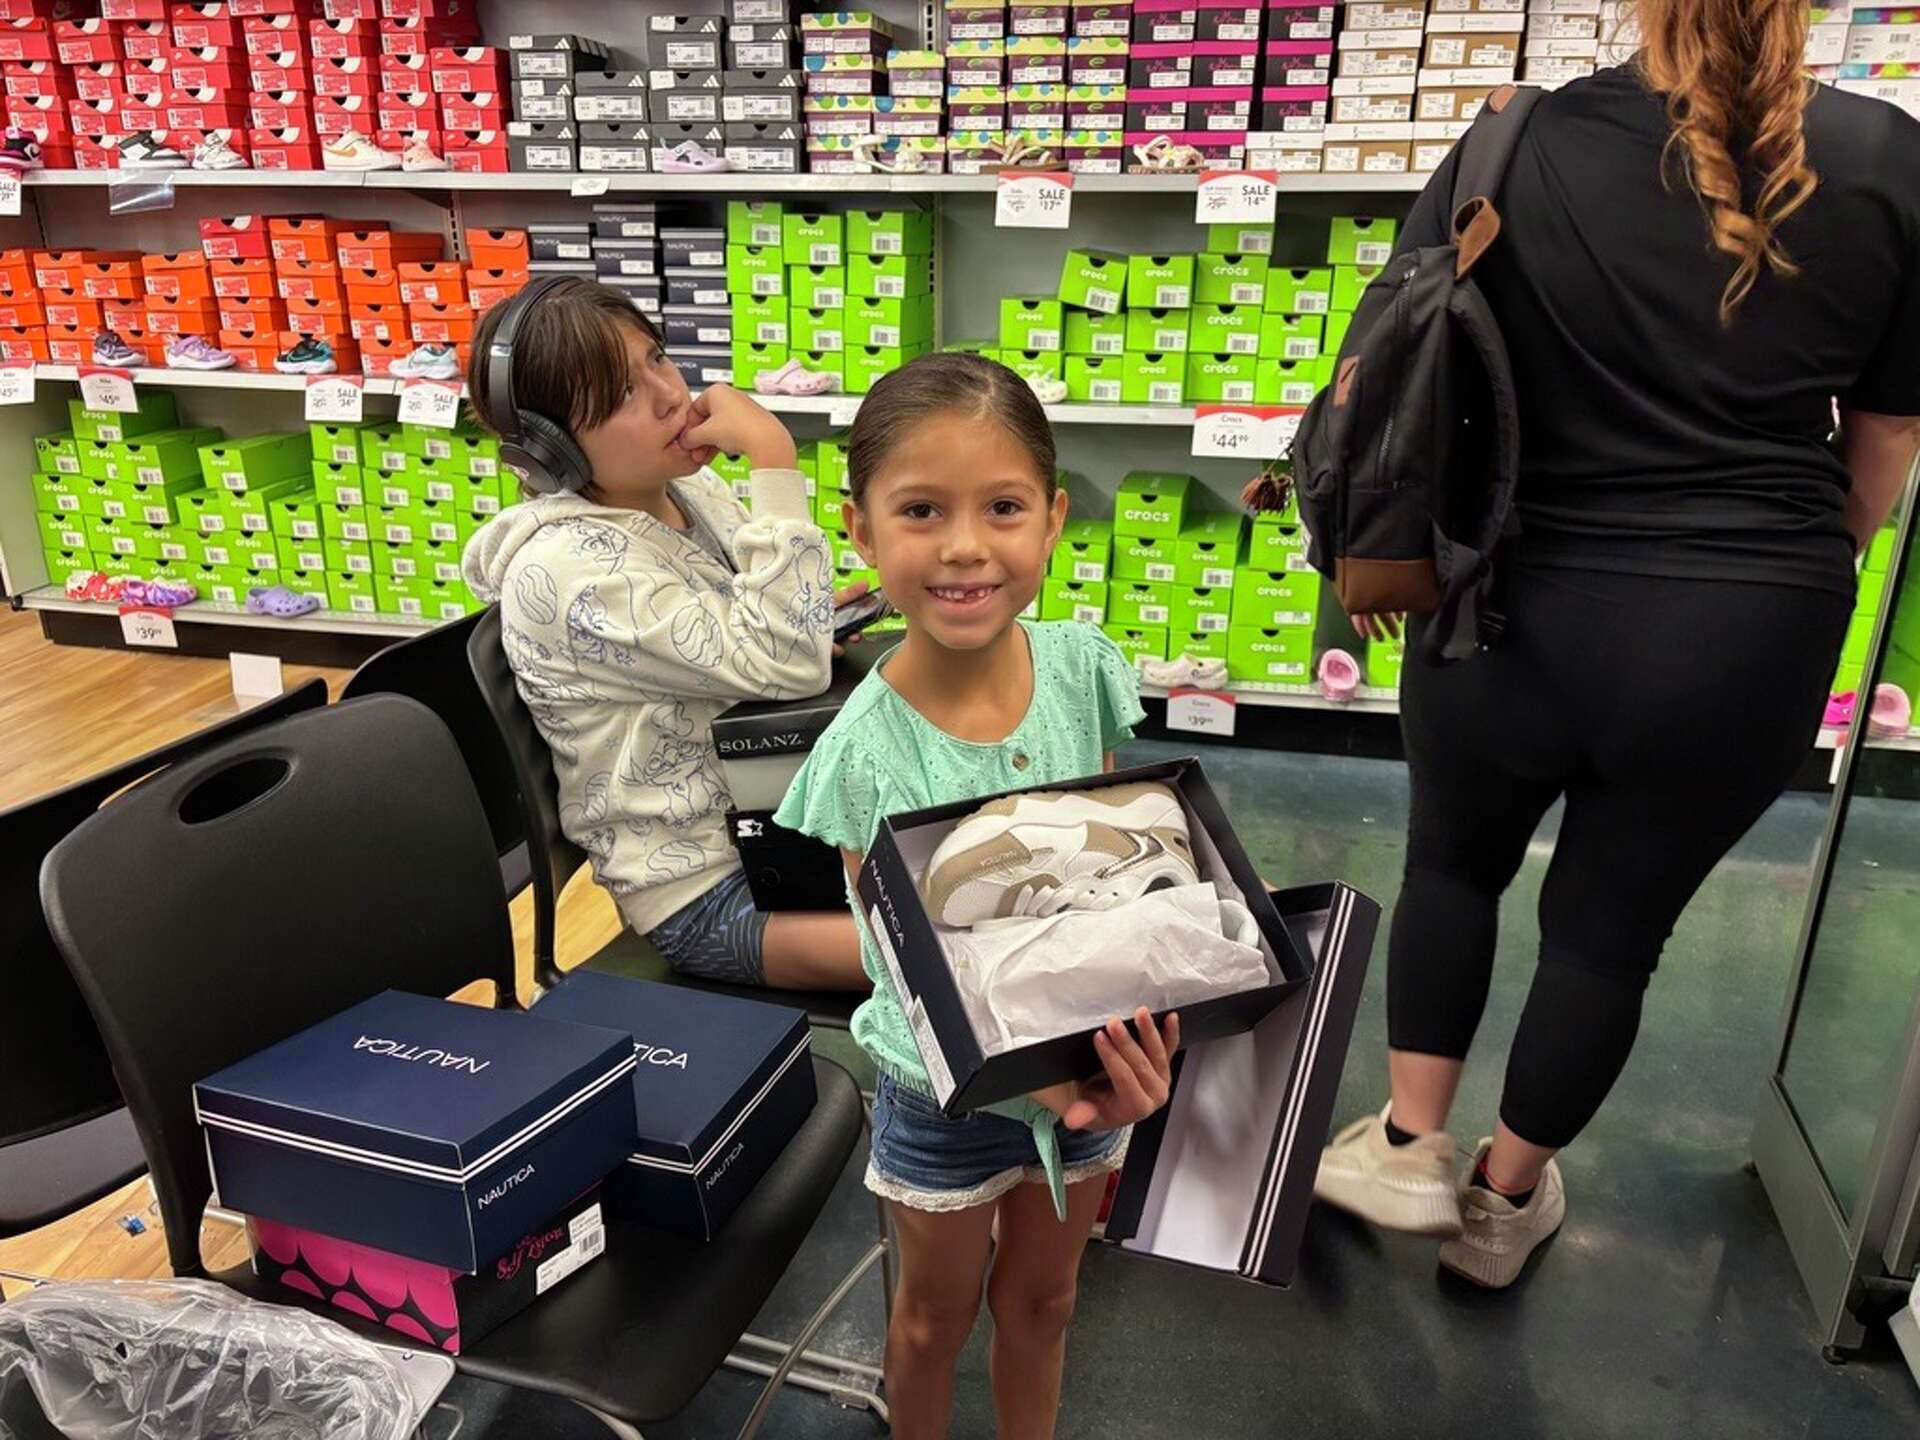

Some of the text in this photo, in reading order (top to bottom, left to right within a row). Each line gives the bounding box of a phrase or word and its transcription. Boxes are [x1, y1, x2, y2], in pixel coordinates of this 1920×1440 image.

[1039, 189, 1065, 200] SALE
[1242, 185, 1271, 196] SALE
[798, 228, 824, 237] crocs
[742, 258, 767, 267] crocs
[1080, 268, 1108, 281] crocs
[1145, 269, 1173, 278] crocs
[1213, 265, 1249, 276] crocs
[747, 307, 772, 316] crocs
[859, 310, 885, 319] crocs
[1015, 312, 1043, 321] crocs
[1207, 314, 1243, 325] crocs
[747, 354, 772, 363] crocs
[859, 358, 885, 367] crocs
[1139, 366, 1167, 374] crocs
[1203, 363, 1239, 374] crocs
[336, 388, 357, 398] SALE
[1124, 509, 1170, 522] crocs
[1129, 546, 1162, 558] crocs
[1192, 553, 1219, 561] crocs
[1057, 591, 1090, 601] crocs
[1124, 592, 1157, 602] crocs
[1256, 586, 1293, 598] crocs
[1187, 598, 1215, 607] crocs
[1118, 639, 1149, 649] crocs
[1184, 643, 1211, 651] crocs
[1251, 642, 1286, 652] crocs
[720, 733, 803, 753] SOLANZ
[871, 859, 905, 948] NAUTICA
[353, 1035, 490, 1074] NAUTICA
[632, 1041, 688, 1070] TICA
[706, 1143, 744, 1190] NAUTICA
[477, 1163, 535, 1210] NAUTICA
